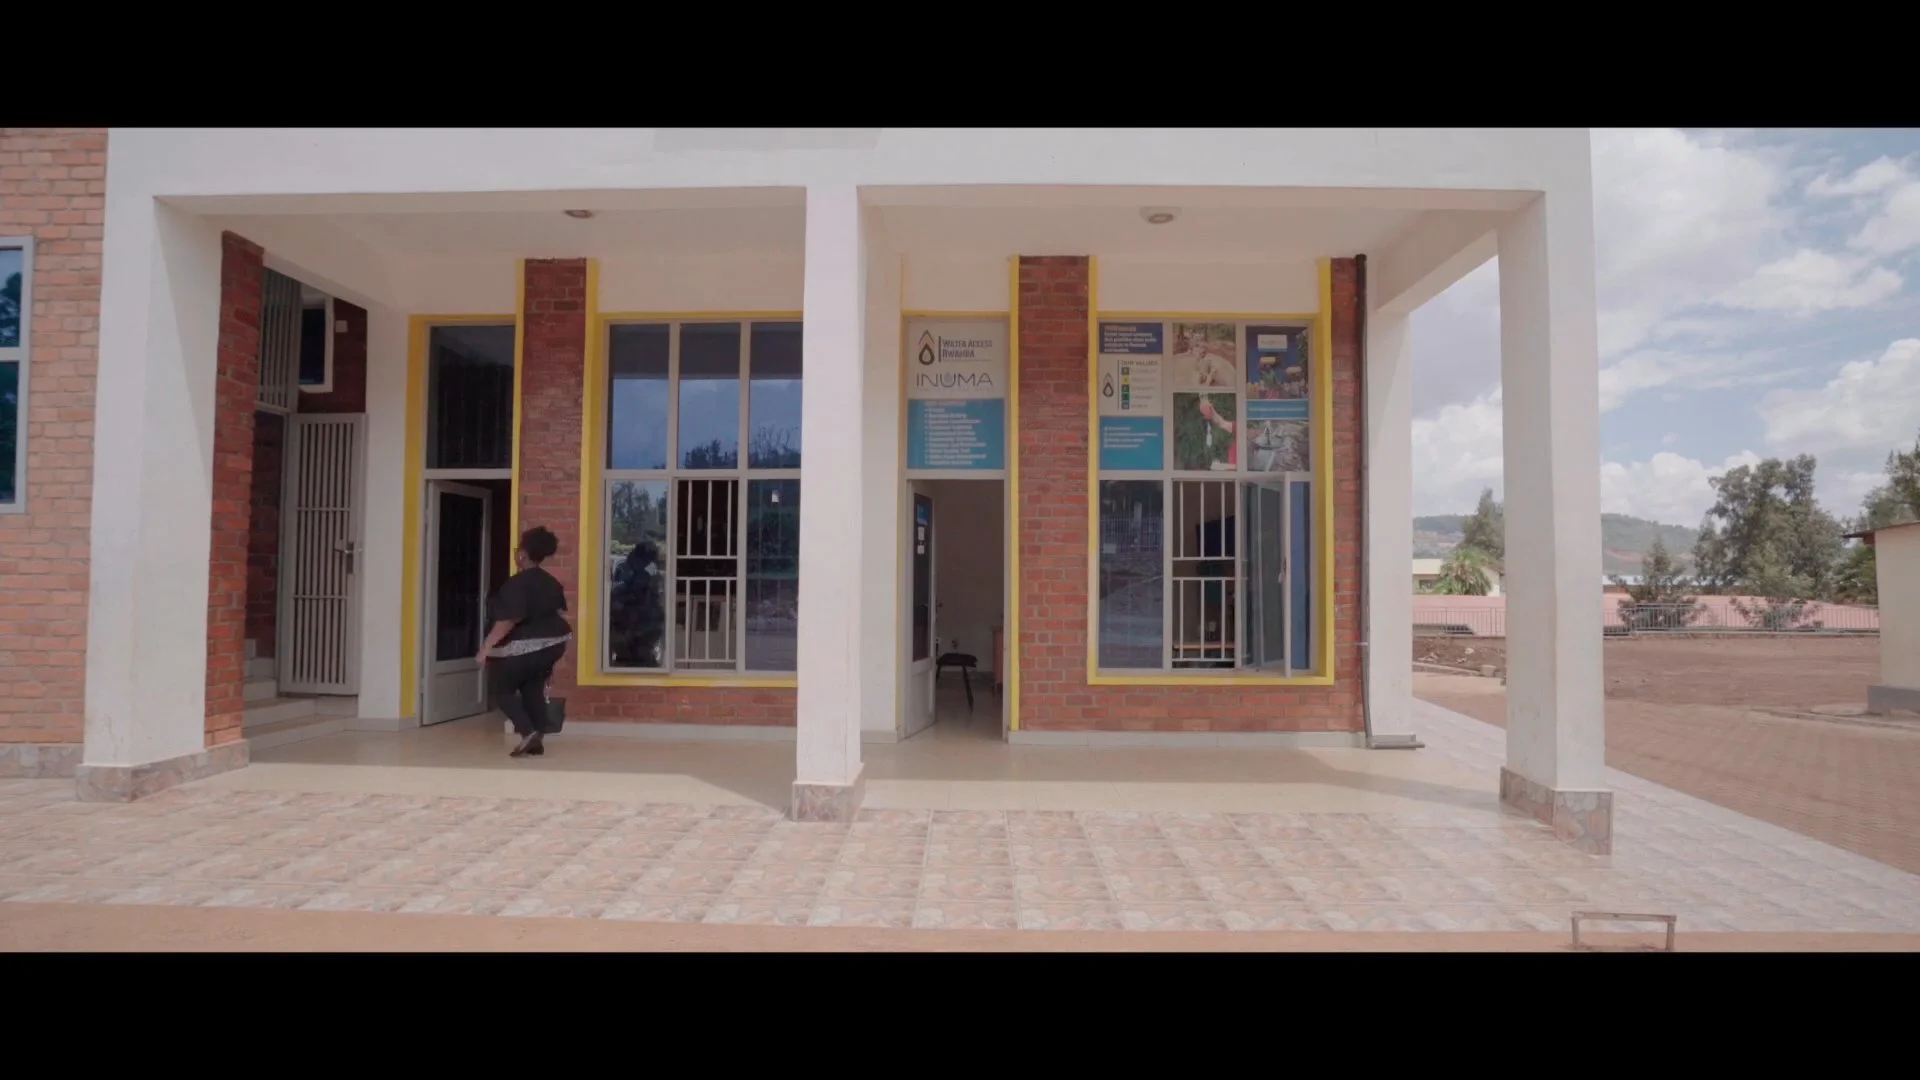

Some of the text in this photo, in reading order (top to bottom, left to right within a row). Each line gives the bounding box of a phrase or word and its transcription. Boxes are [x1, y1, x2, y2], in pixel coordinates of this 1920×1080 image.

[942, 339, 993, 348] WATER ACCESS
[942, 349, 975, 358] RWANDA
[916, 372, 993, 388] INUMA
